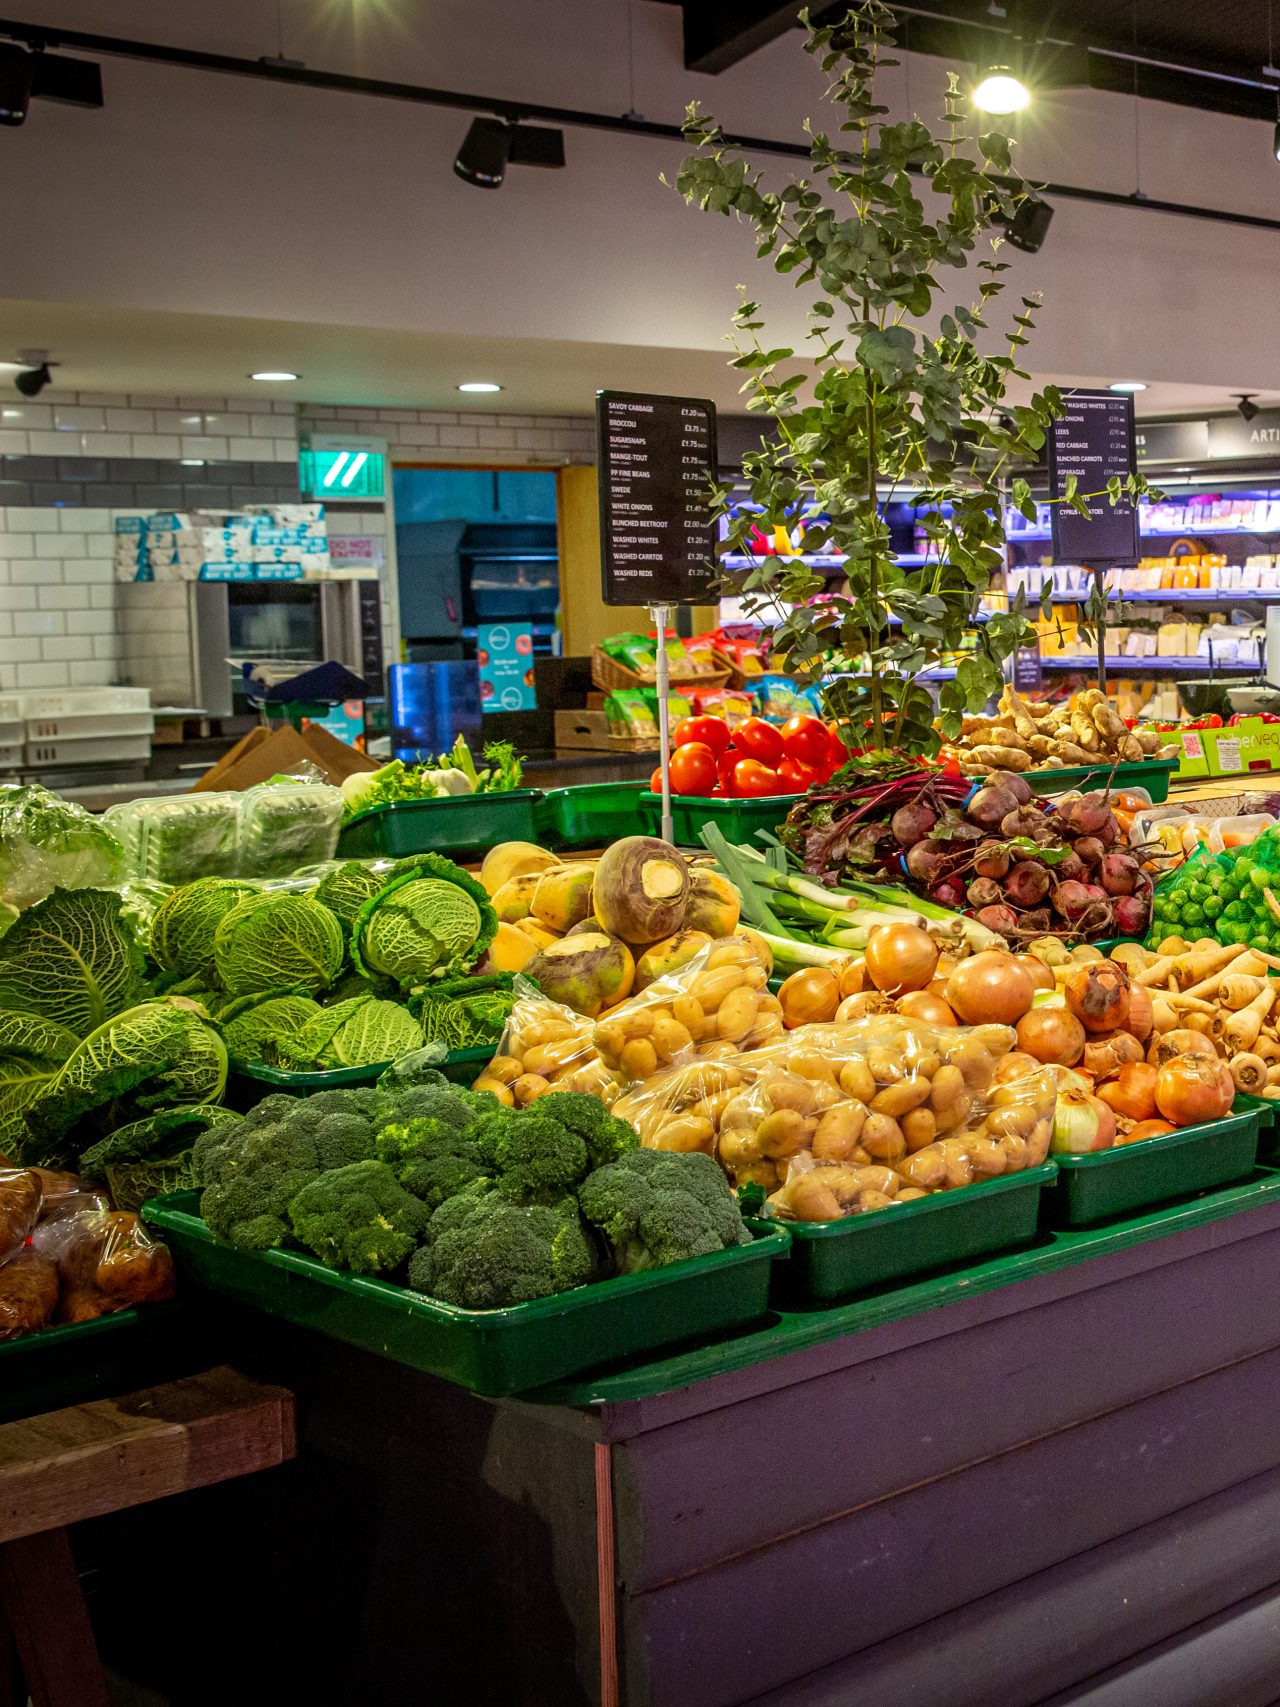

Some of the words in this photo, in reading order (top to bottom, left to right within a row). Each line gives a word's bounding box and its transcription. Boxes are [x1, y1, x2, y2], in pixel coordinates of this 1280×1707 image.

[608, 402, 627, 410] SAVOY
[628, 404, 654, 413] CABBAGE
[609, 419, 637, 428] BROCCOLI
[609, 436, 647, 445] SUGARSNAPS
[610, 452, 648, 461] MANGE-TOUT
[632, 470, 651, 478] BEANS
[611, 486, 631, 494] SWEDE
[612, 502, 630, 510] WHITE
[612, 519, 639, 527] BUNCHED
[640, 520, 668, 528] BEETROOT
[349, 539, 372, 549] NOT
[613, 552, 637, 560] WASHED
[613, 569, 638, 577] WASHED
